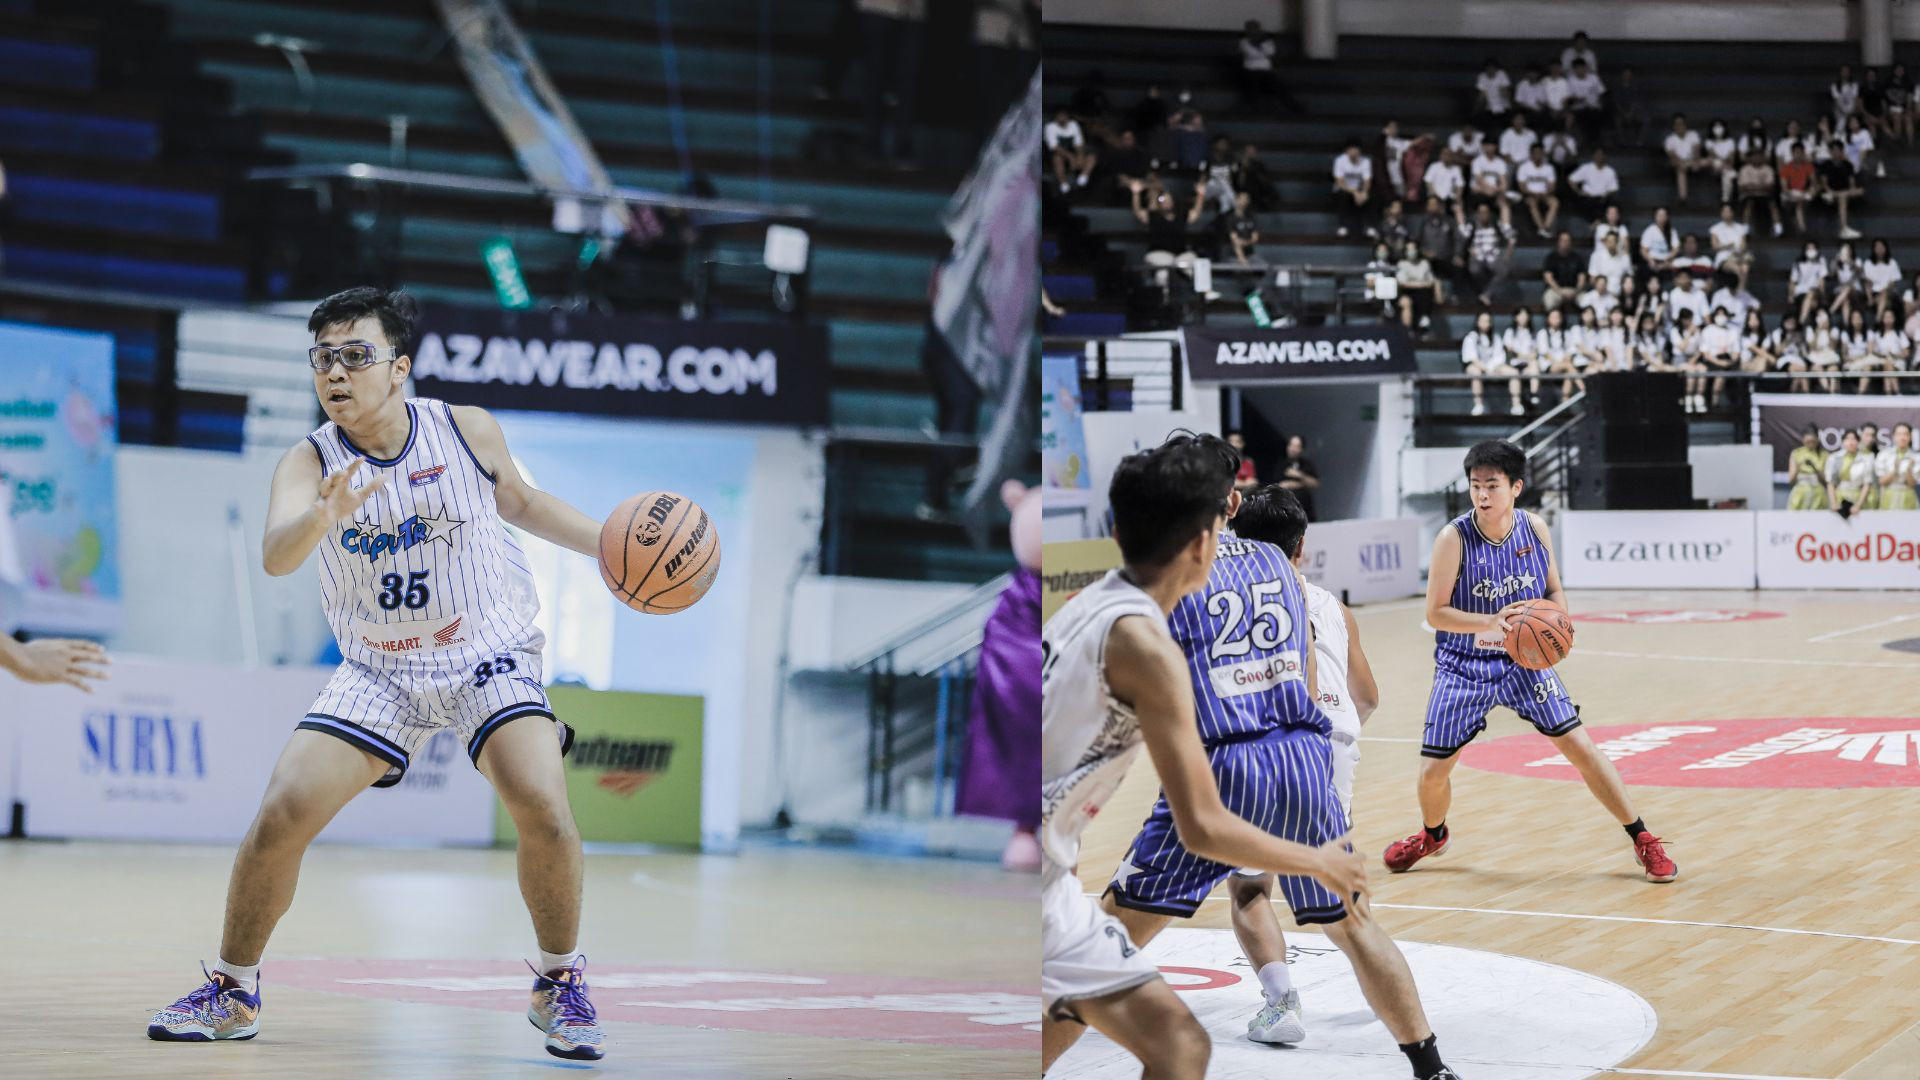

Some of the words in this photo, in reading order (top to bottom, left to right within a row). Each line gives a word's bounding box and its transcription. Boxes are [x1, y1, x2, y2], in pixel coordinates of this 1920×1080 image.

[413, 331, 778, 396] AZAWEAR.COM
[1216, 339, 1390, 365] AZAWEAR.COM
[648, 494, 681, 526] DBL
[1795, 532, 1871, 562] Good
[1877, 532, 1920, 571] Da
[378, 569, 430, 611] 35
[1207, 578, 1293, 661] 25
[362, 636, 380, 650] One
[434, 637, 466, 648] HONDA
[1533, 677, 1561, 704] 34
[81, 711, 206, 778] SURYA
